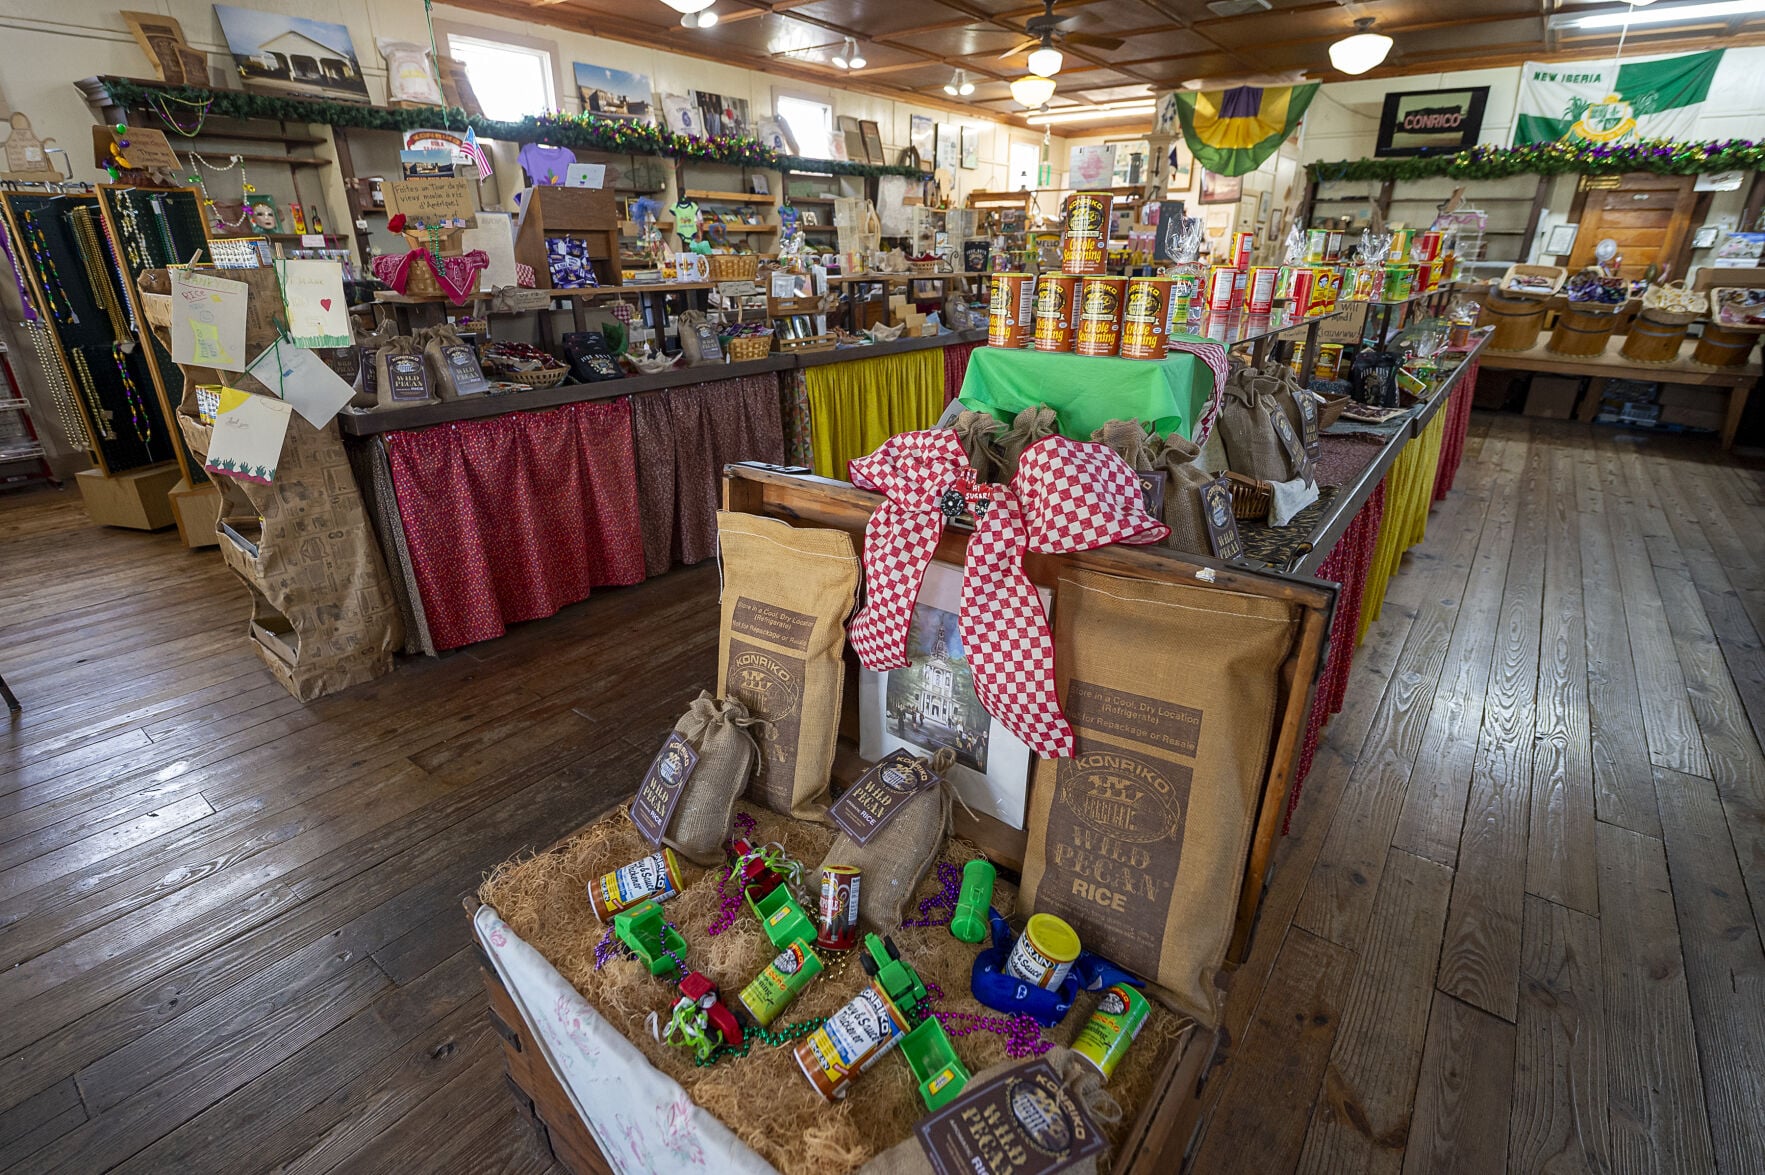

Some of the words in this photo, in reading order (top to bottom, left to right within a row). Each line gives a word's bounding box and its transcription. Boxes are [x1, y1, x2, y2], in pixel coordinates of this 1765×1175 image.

[1533, 71, 1558, 82] NEW
[1561, 73, 1602, 84] IBERIA
[1404, 113, 1462, 129] CONRICO
[395, 380, 423, 388] PECAN
[780, 613, 791, 623] Dry
[736, 654, 790, 682] KONRIKO
[1094, 692, 1103, 700] in
[1139, 703, 1155, 714] Dry
[1158, 707, 1200, 725] Location
[1101, 703, 1160, 726] (Refrigerate)
[1096, 717, 1148, 737] Repackage
[1150, 730, 1161, 739] or
[1161, 734, 1196, 751] Resale
[1075, 755, 1169, 795] KONRIKO
[643, 785, 666, 817] PECAN
[649, 776, 669, 803] WILD
[852, 787, 888, 818] PECAN
[864, 780, 893, 806] WILD
[860, 810, 877, 826] RICE
[1072, 825, 1151, 870] WILD
[1053, 841, 1161, 902] PECAN
[1071, 878, 1128, 913] RICE
[1020, 958, 1042, 979] Sauce
[858, 1017, 881, 1043] Sauce
[1035, 1074, 1087, 1141] KONRIKO
[983, 1103, 1028, 1166] WILD
